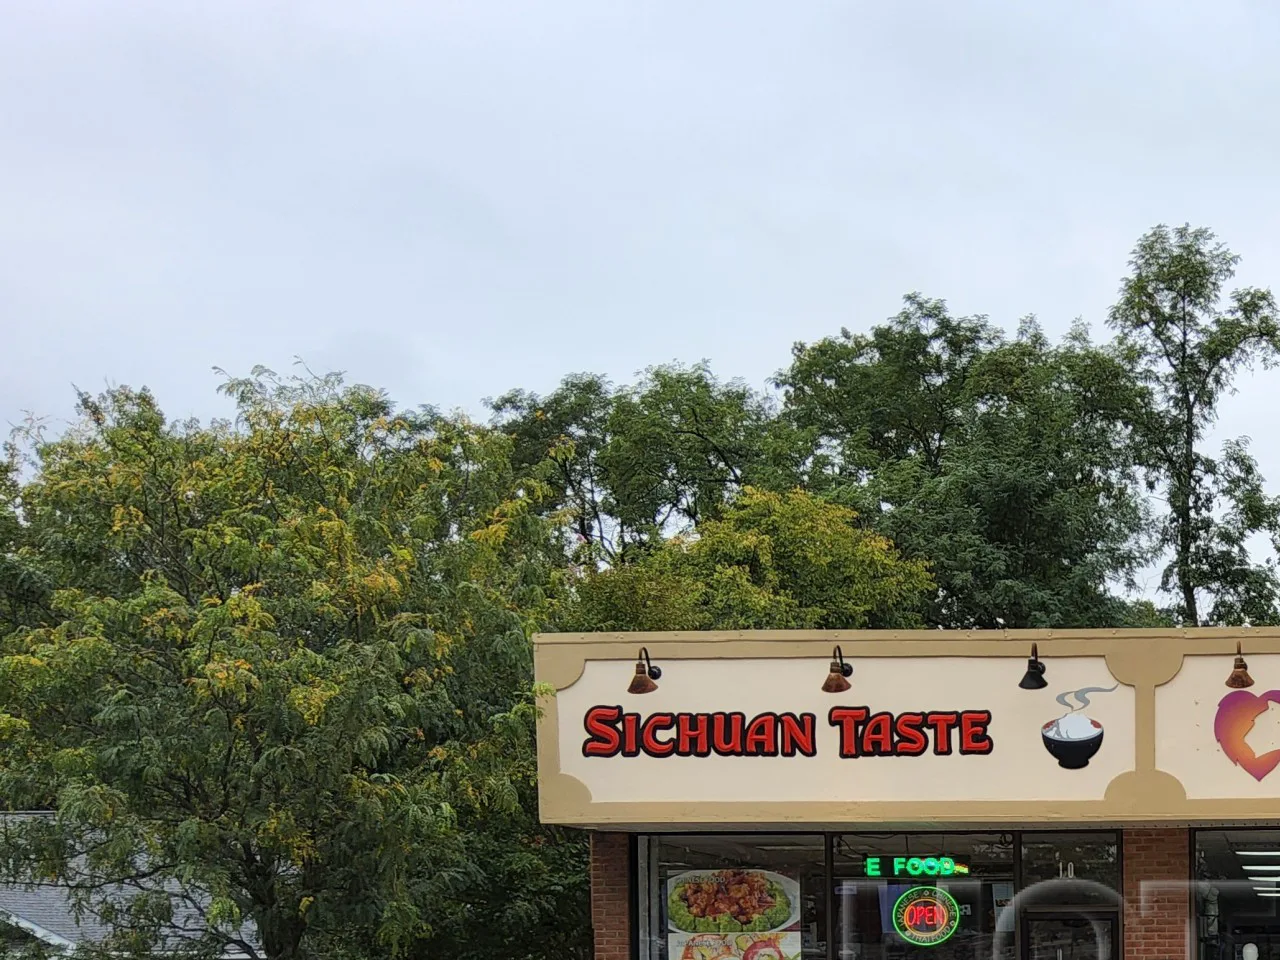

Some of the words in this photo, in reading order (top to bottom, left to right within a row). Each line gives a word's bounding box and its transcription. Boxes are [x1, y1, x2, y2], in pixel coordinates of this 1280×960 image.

[582, 704, 817, 758] SICHUAN
[828, 705, 993, 759] TASTE
[1059, 861, 1074, 879] 10
[907, 904, 945, 926] OPEN
